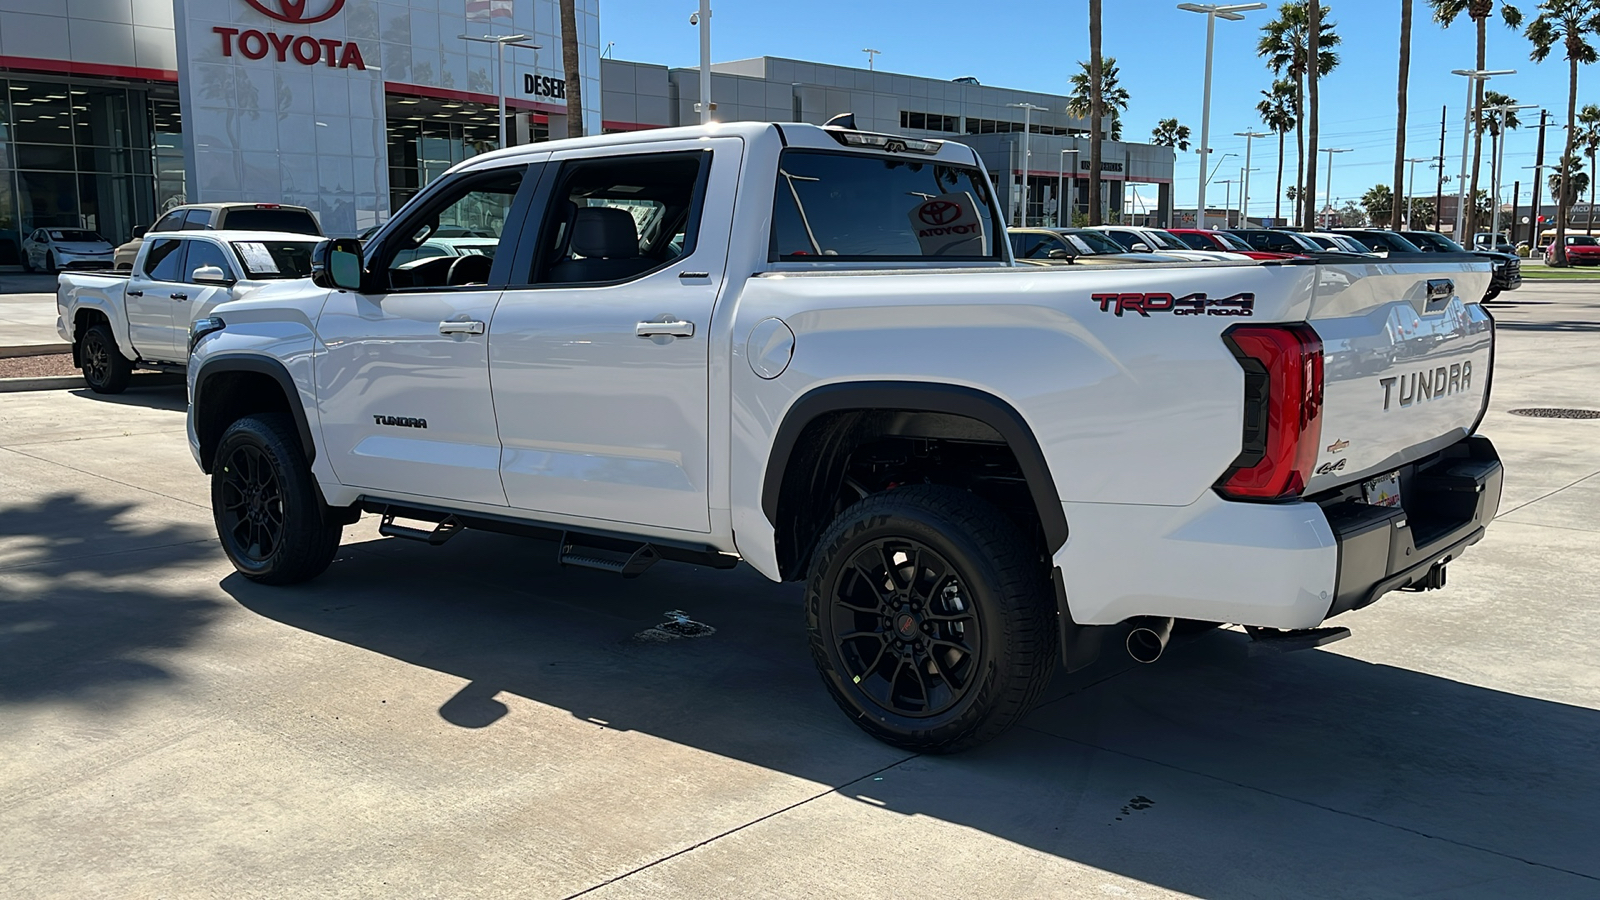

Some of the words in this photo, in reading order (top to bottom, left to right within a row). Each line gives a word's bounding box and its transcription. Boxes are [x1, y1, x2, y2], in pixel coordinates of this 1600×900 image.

[212, 26, 367, 71] TOYOTA
[524, 73, 566, 99] DESER
[1091, 292, 1175, 318] TRD
[1175, 292, 1255, 311] 4x4
[1173, 308, 1205, 316] OFF
[1207, 308, 1253, 317] ROAD
[1379, 360, 1472, 412] TUNDRA
[373, 414, 428, 429] TUNDRA
[900, 616, 914, 633] TRD
